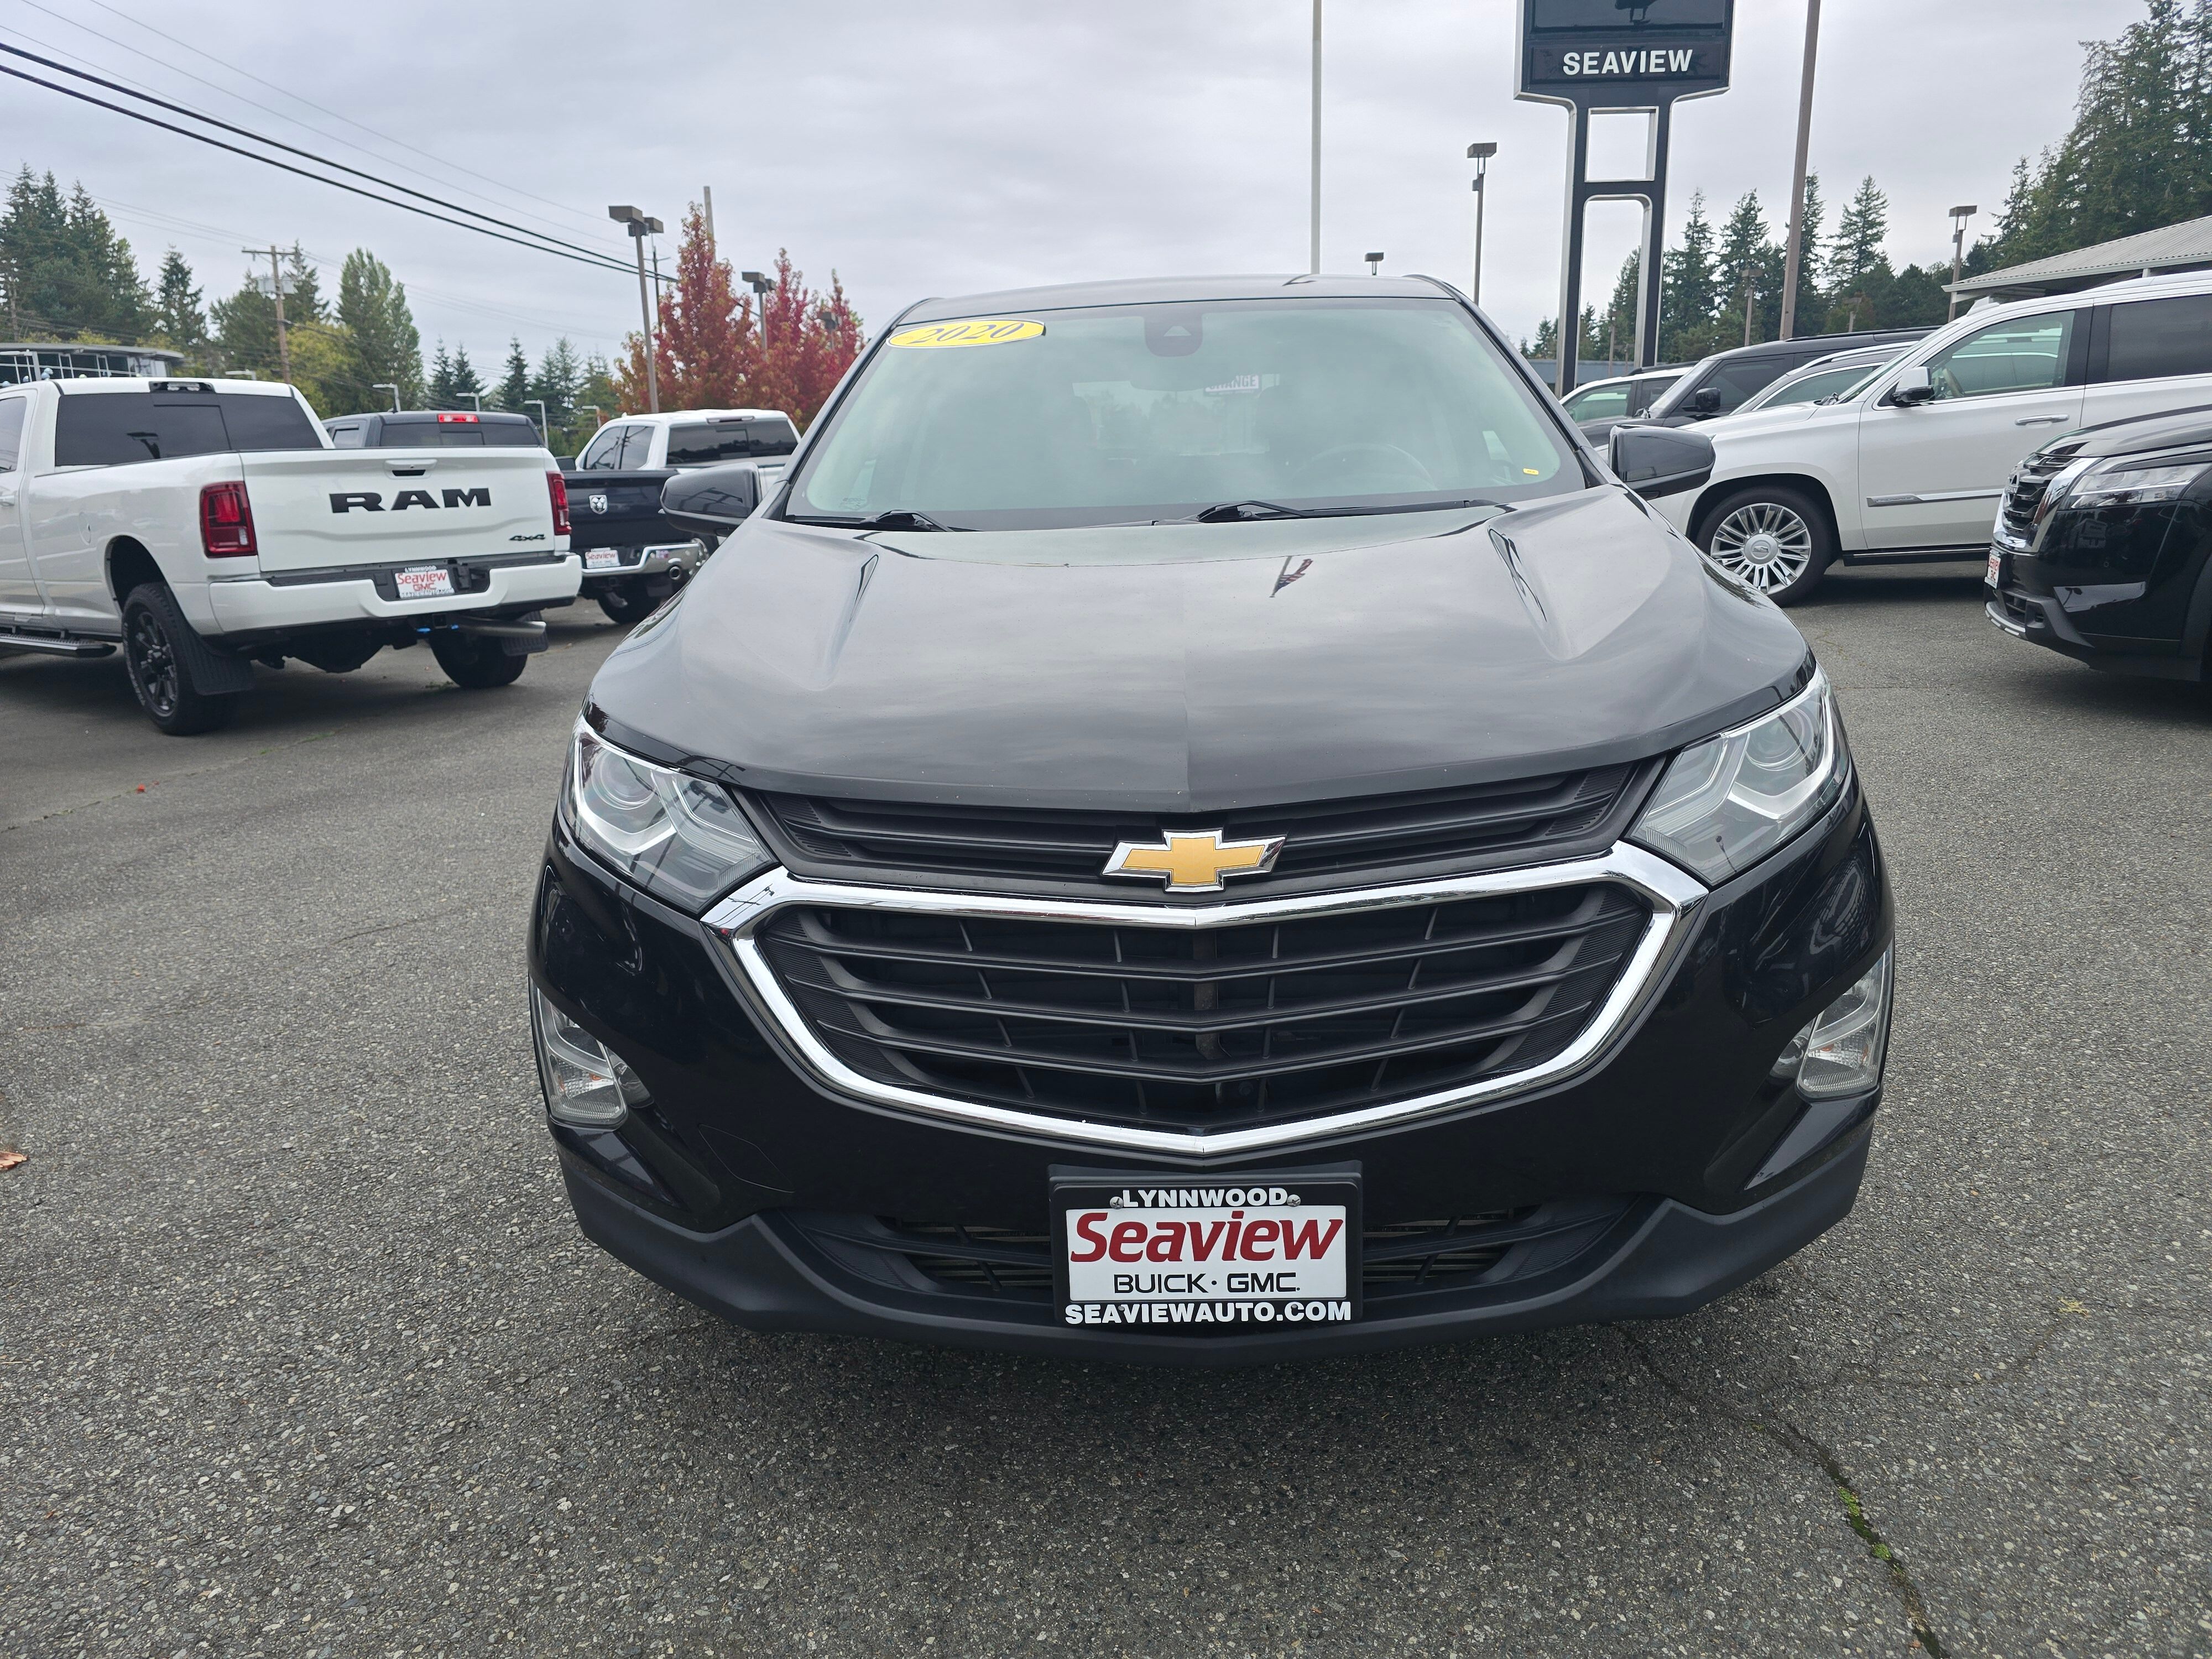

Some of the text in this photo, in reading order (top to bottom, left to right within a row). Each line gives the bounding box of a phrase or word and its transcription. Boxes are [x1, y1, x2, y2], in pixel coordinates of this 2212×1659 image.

[1563, 49, 1693, 75] SEAVIEW
[906, 322, 1024, 344] 2020
[329, 488, 491, 513] RAM
[398, 571, 446, 584] Seaview
[413, 583, 436, 591] GMC
[1123, 1188, 1288, 1207] LYNNWOOD
[1070, 1211, 1344, 1262] Seaview
[1113, 1274, 1209, 1293] BUICK
[1065, 1301, 1351, 1324] SEAVIEWAUTO.COM
